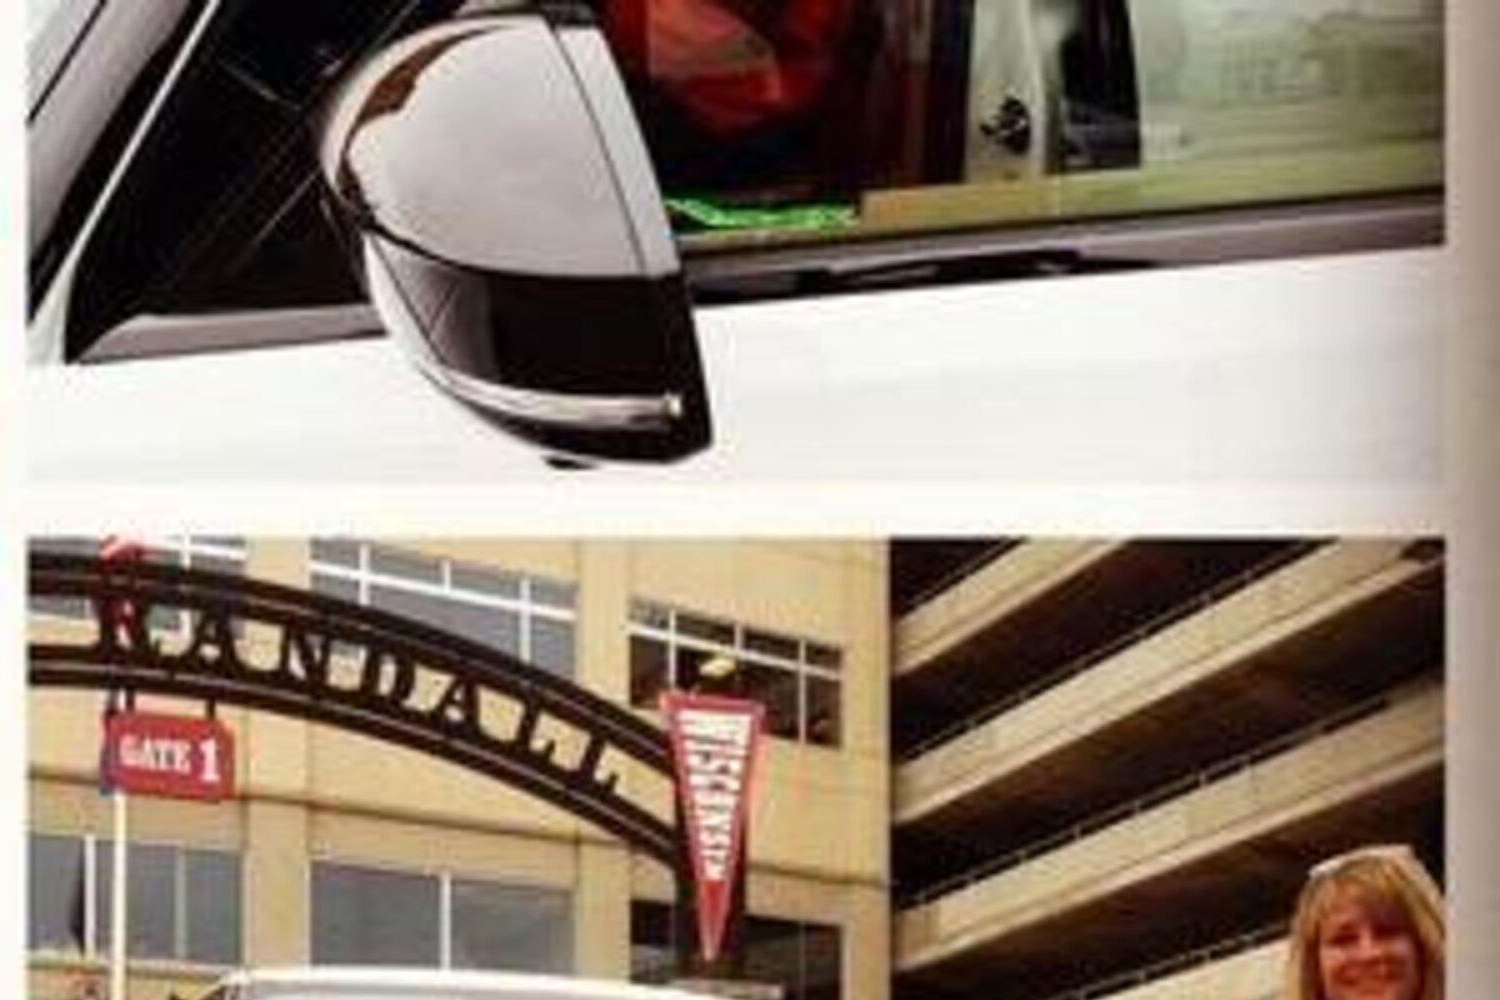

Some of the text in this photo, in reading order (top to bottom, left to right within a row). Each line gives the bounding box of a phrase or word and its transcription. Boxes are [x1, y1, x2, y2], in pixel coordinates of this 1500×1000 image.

[92, 595, 626, 802] RANDALL
[119, 735, 221, 783] GATE 1
